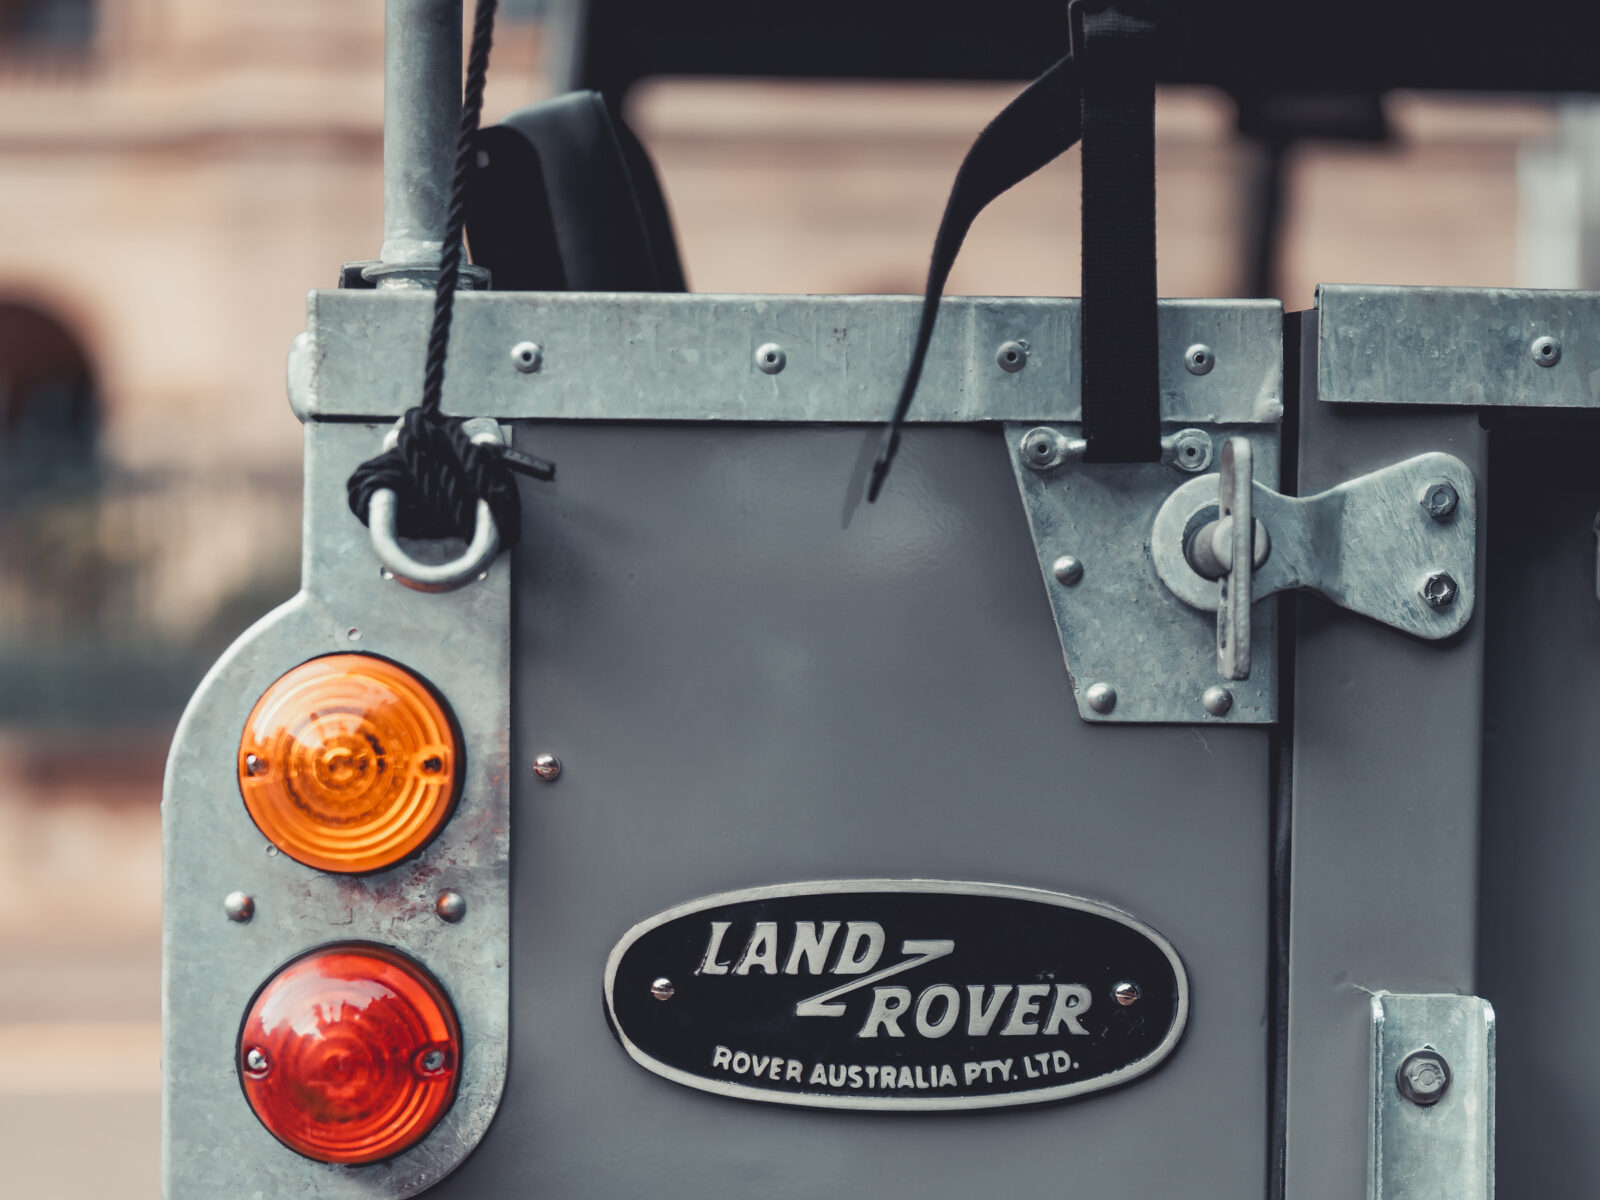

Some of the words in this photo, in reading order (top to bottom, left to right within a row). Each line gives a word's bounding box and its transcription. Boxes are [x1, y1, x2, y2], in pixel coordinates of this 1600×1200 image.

[694, 921, 886, 976] LAND
[857, 983, 1092, 1039] ROVER
[712, 1045, 804, 1083] ROVER
[809, 1063, 958, 1090] AUSTRALIA
[963, 1058, 1019, 1086] PTY.
[1024, 1050, 1080, 1078] LTD.
